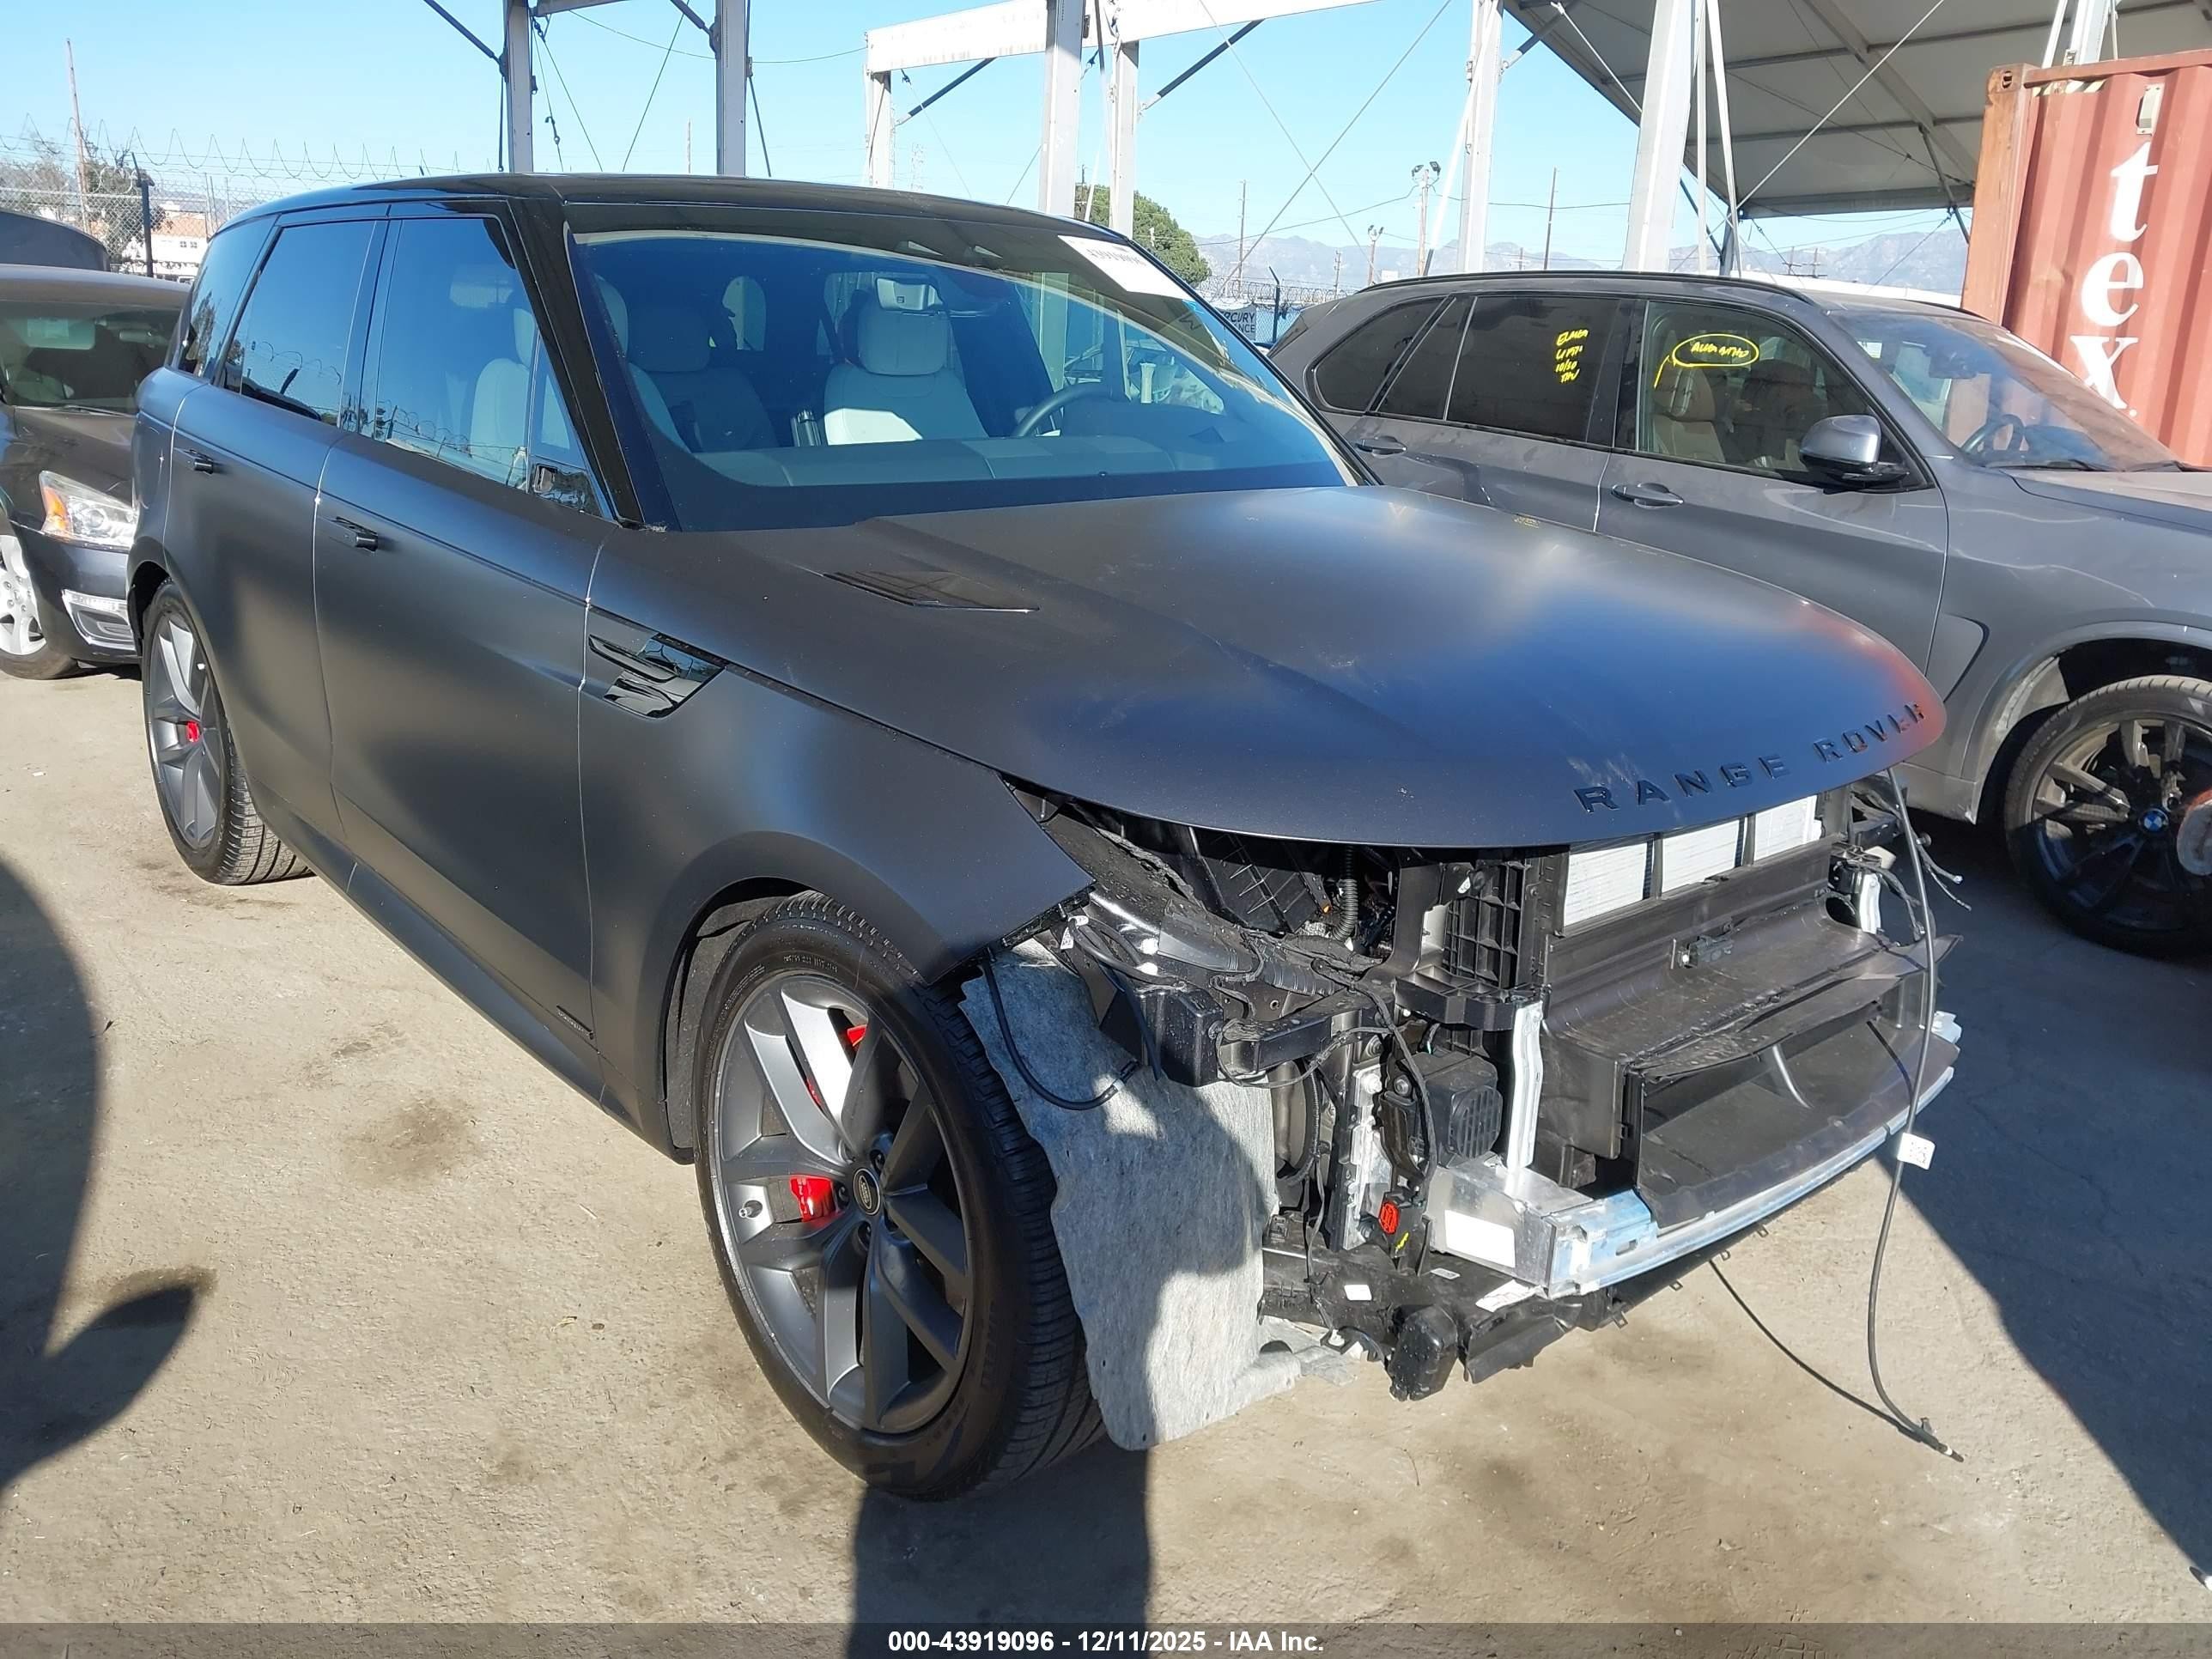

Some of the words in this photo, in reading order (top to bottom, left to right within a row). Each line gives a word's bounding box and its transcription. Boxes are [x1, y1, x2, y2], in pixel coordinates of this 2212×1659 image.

[1233, 324, 1256, 333] NCE
[1573, 753, 1791, 813] RANGE
[1813, 701, 1927, 763] ROVER
